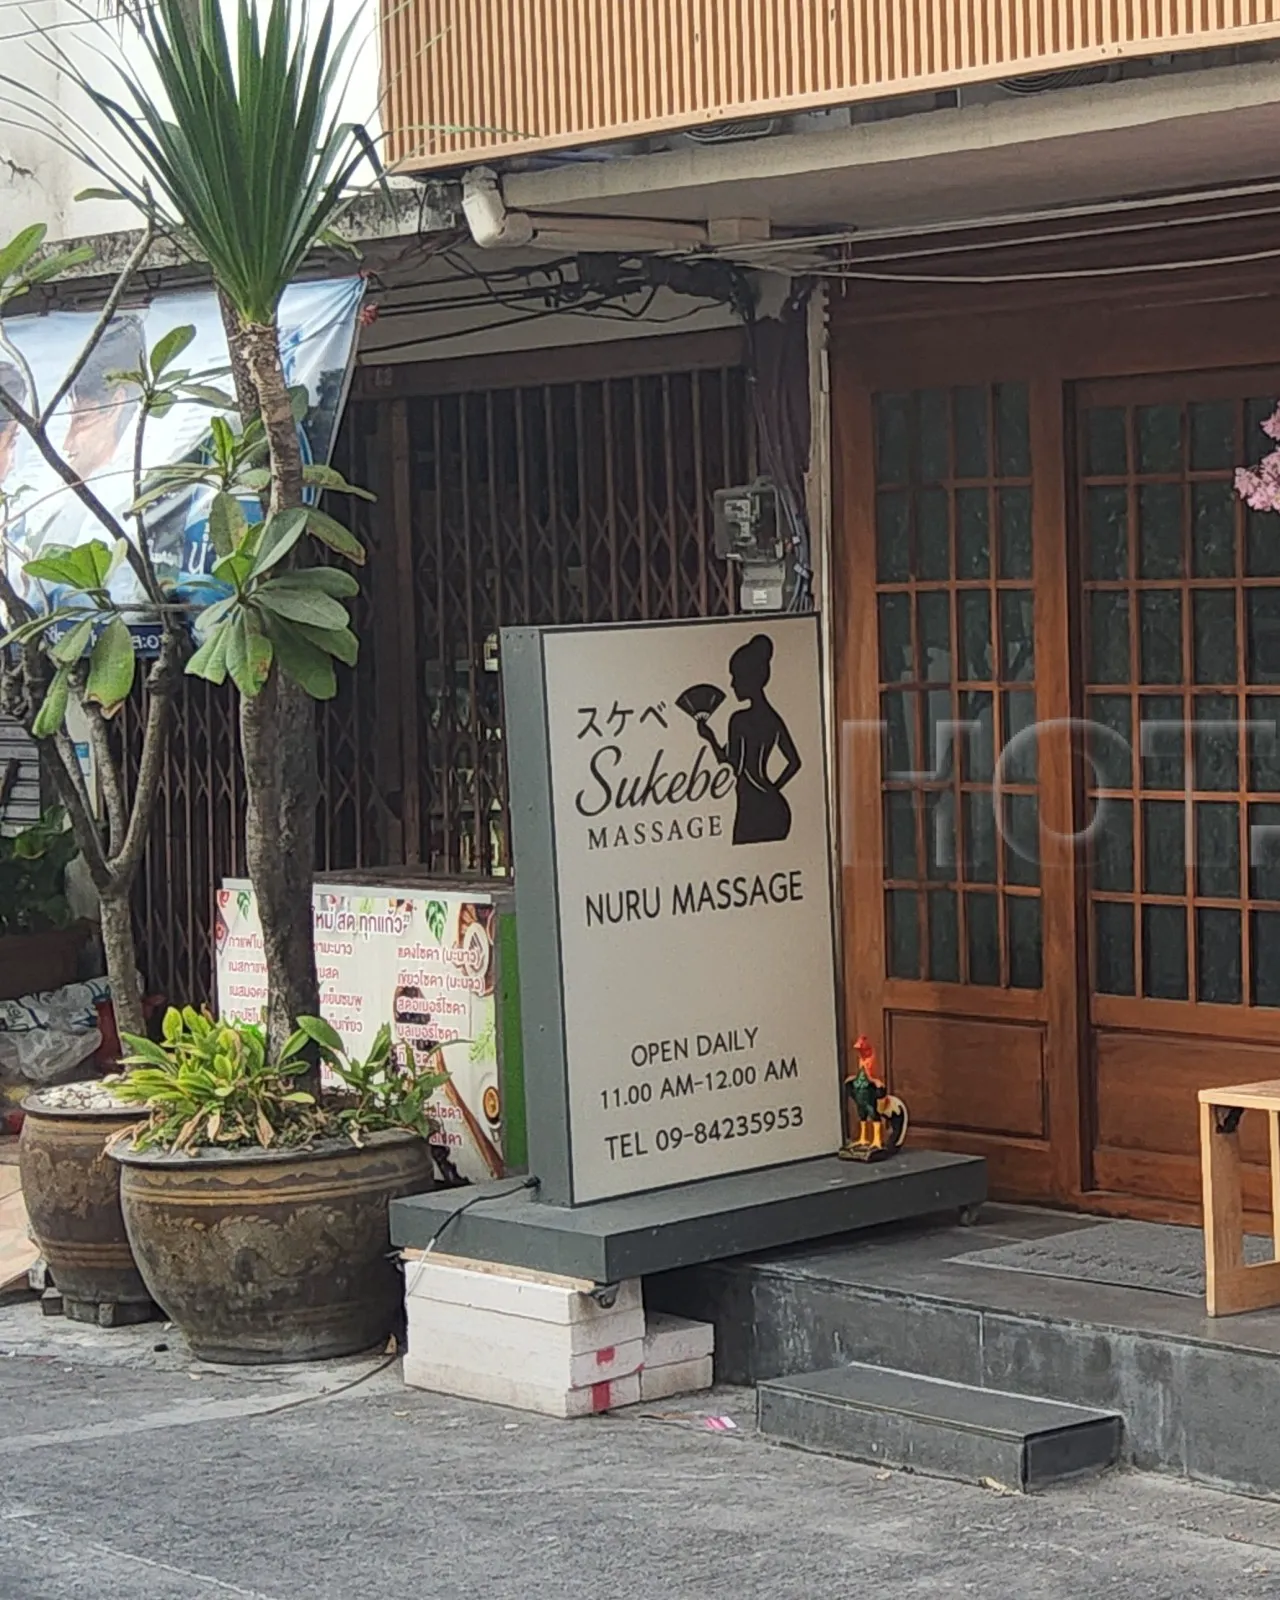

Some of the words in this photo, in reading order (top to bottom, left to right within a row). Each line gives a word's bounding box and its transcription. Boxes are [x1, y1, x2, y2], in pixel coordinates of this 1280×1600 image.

[577, 700, 668, 739] スケベ
[575, 745, 736, 817] Sukebe
[588, 815, 722, 850] MASSAGE
[586, 886, 660, 927] NURU
[672, 870, 803, 915] MASSAGE
[631, 1037, 688, 1067] OPEN
[697, 1026, 758, 1057] DAILY
[600, 1083, 651, 1110] 11.00
[764, 1057, 798, 1082] AM
[605, 1131, 648, 1160] TEL
[656, 1106, 803, 1151] 09-84235953
